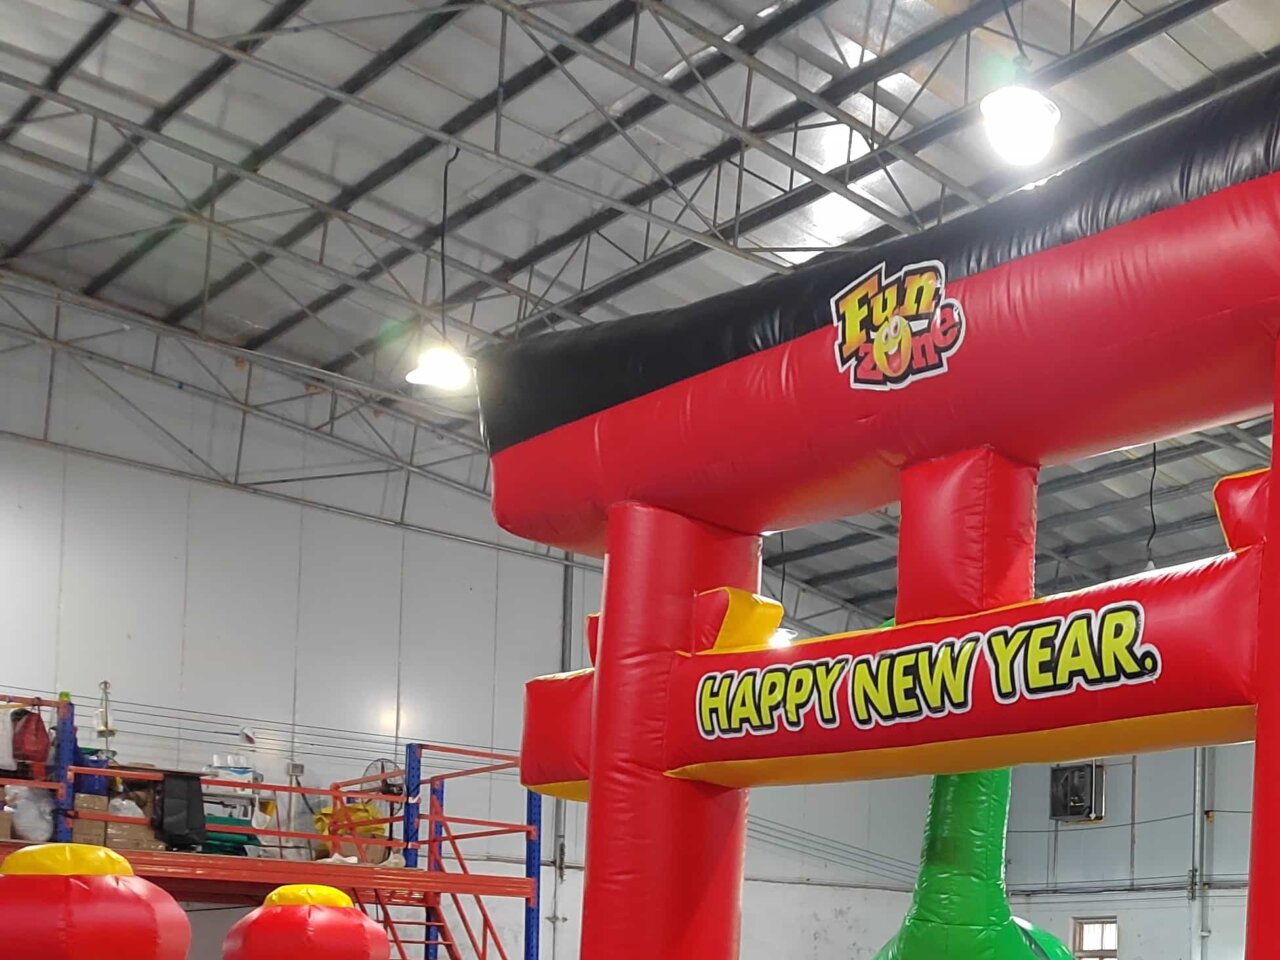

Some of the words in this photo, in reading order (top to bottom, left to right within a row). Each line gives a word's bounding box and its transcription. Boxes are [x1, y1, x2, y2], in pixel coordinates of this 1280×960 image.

[837, 270, 938, 358] Fun
[700, 660, 845, 734] HAPPY
[851, 638, 974, 722] NEW
[986, 605, 1157, 700] YEAR.
